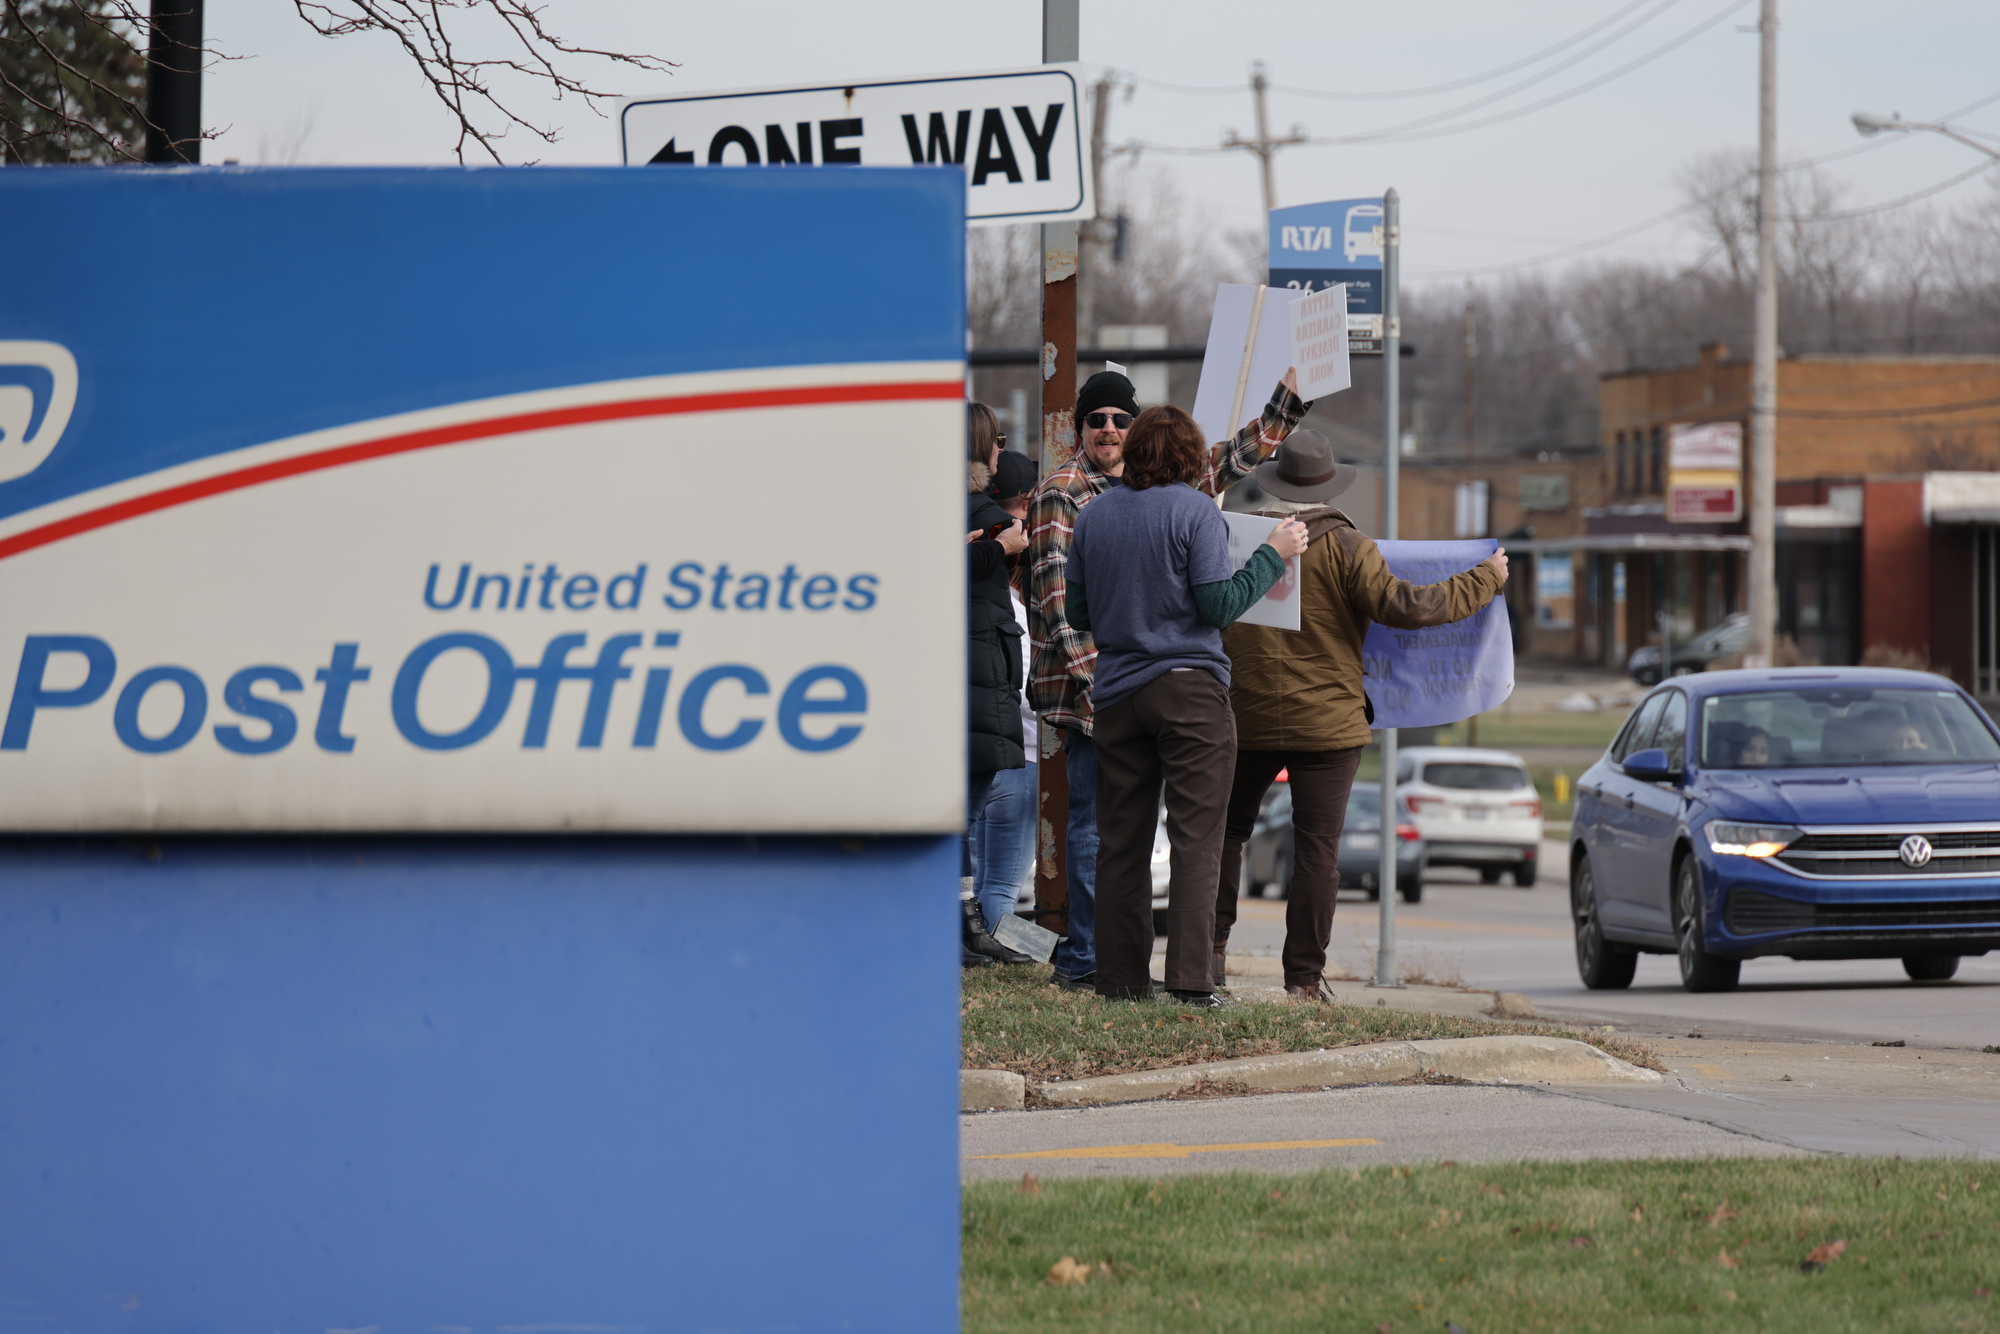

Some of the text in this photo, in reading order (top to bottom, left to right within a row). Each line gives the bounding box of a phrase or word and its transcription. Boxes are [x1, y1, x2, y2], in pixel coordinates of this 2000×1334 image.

[901, 103, 1064, 186] WAY
[1281, 226, 1332, 252] RTA
[423, 561, 880, 611] United States
[0, 630, 869, 756] Post Office
